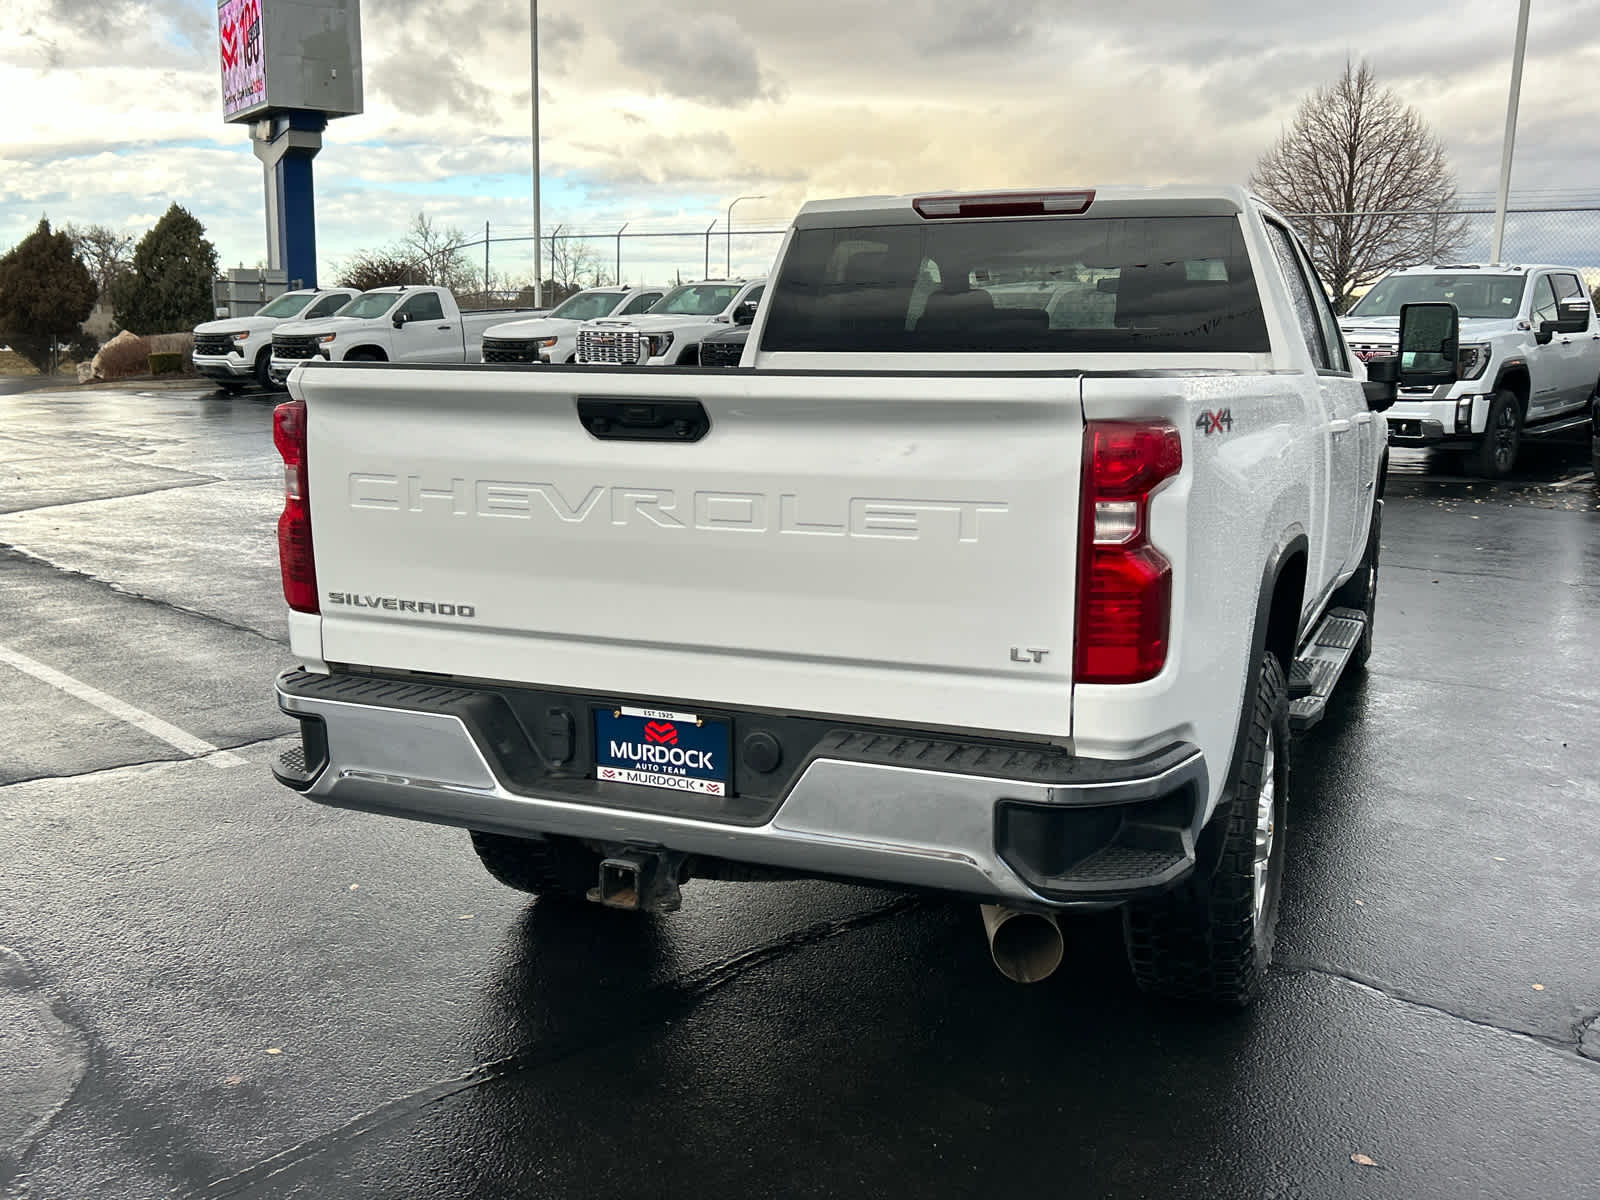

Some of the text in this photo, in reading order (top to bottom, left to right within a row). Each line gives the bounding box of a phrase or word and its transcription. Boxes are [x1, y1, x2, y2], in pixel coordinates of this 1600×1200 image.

[348, 472, 1009, 543] CHEVROLET
[328, 592, 475, 618] SILVERADO
[1010, 644, 1048, 663] LT
[610, 740, 714, 770] MURDOCK
[635, 763, 686, 775] AUTO TEAM
[626, 772, 696, 790] MURDOCK
